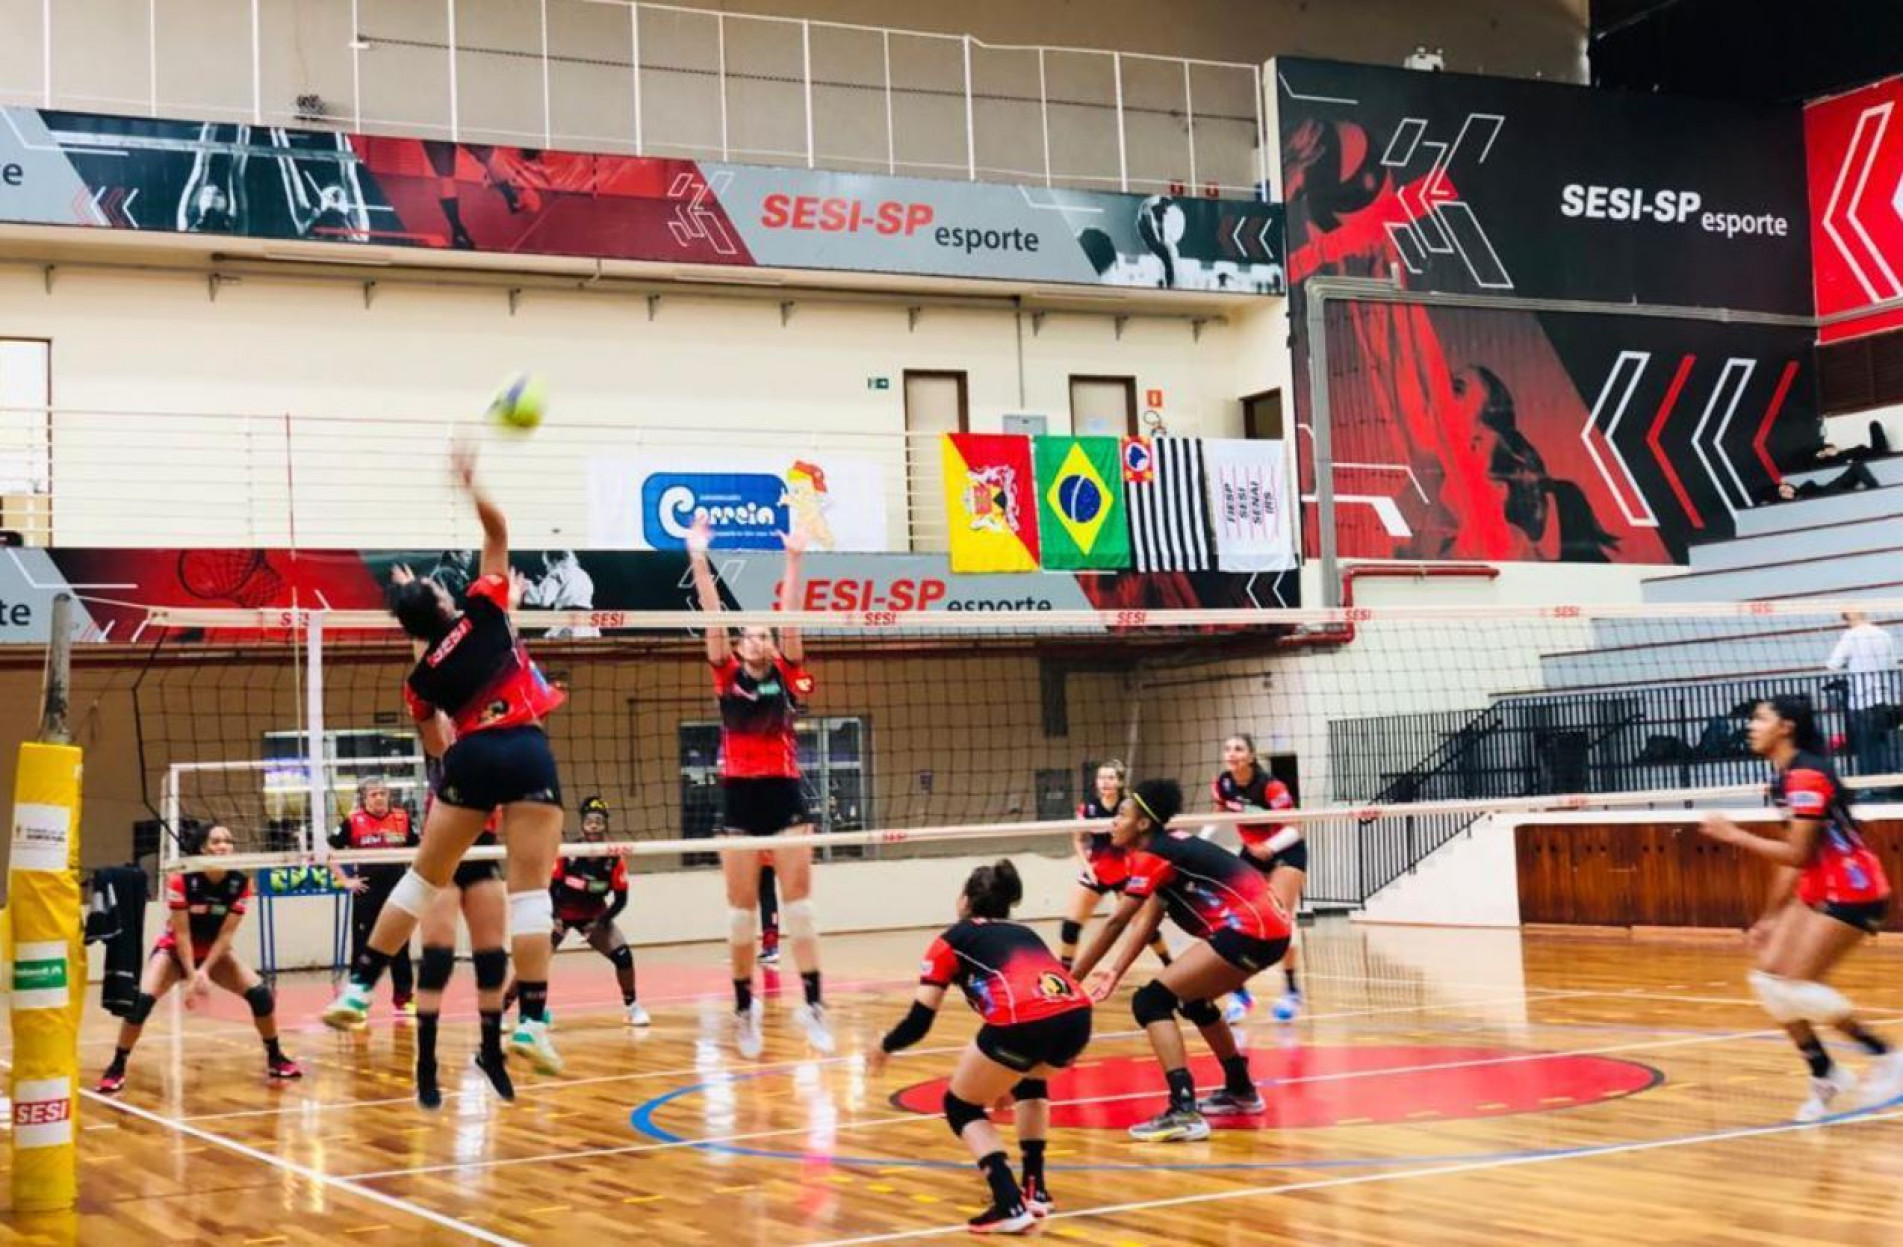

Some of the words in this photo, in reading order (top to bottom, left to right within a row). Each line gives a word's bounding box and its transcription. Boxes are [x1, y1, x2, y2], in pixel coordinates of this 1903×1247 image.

[3, 163, 23, 186] e
[1560, 184, 1701, 223] SESI-SP
[1702, 212, 1788, 239] esporte
[761, 194, 934, 236] SESI-SP
[934, 226, 1039, 254] esporte
[589, 613, 625, 627] SESI
[864, 612, 896, 626] SESI
[1117, 611, 1147, 625] SESI
[17, 1101, 67, 1124] SESI
